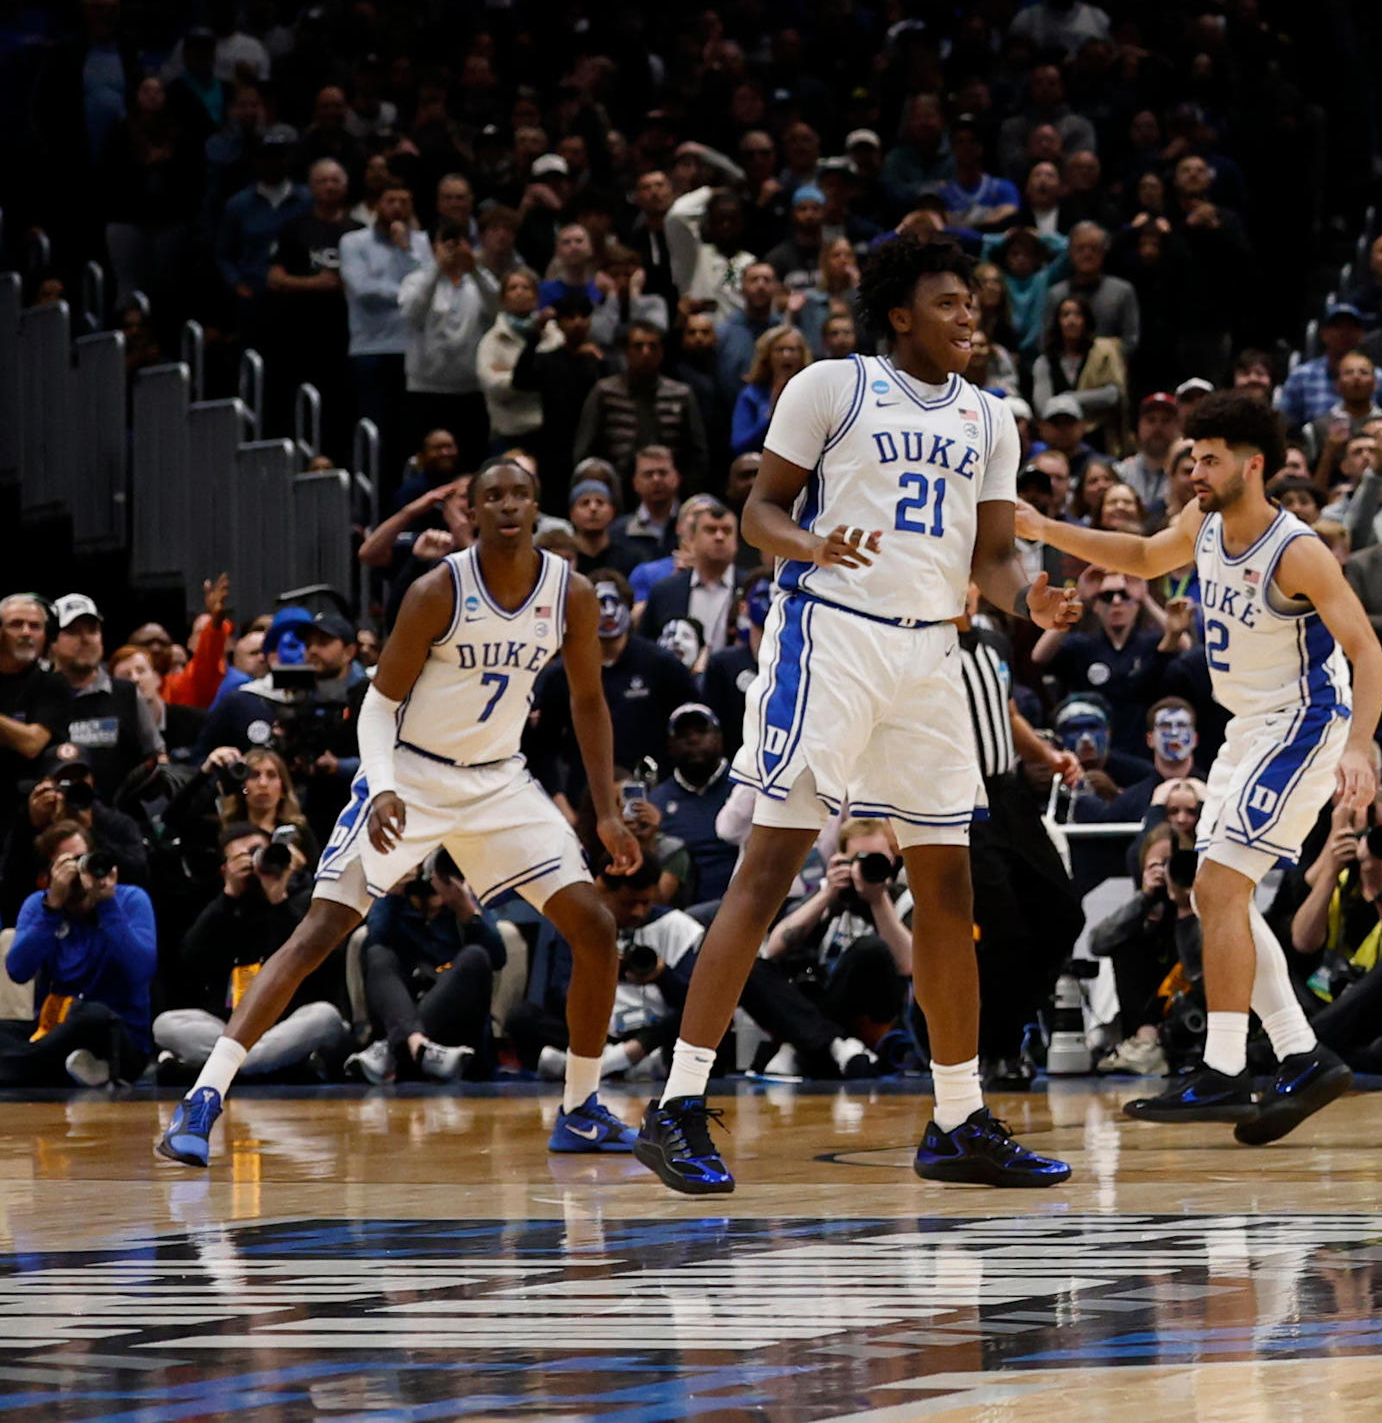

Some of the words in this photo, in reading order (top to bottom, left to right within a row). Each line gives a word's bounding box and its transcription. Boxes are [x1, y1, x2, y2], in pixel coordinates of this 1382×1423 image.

[872, 432, 980, 480] DUKE
[895, 472, 946, 538] 21
[1204, 579, 1262, 629] UKE
[456, 641, 550, 673] DUKE
[1206, 619, 1230, 672] 2
[477, 672, 510, 723] 7
[764, 724, 789, 756] D
[1248, 784, 1278, 814] D
